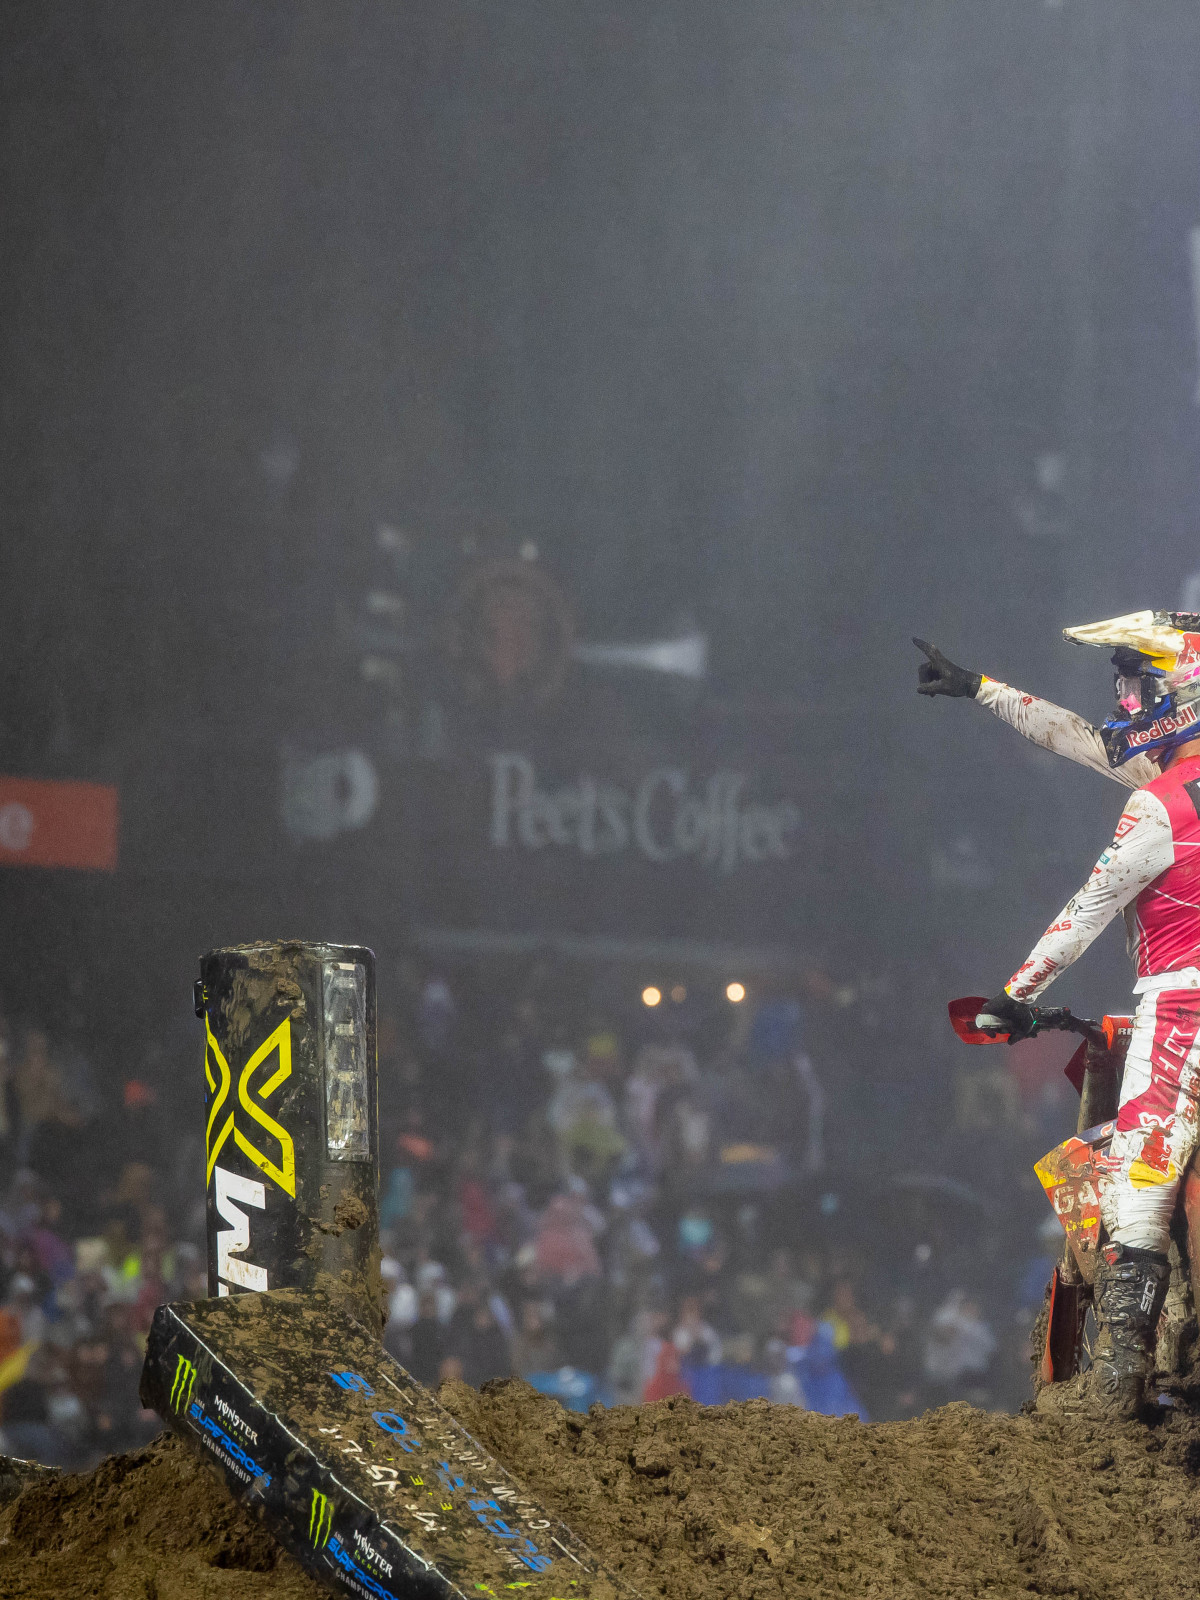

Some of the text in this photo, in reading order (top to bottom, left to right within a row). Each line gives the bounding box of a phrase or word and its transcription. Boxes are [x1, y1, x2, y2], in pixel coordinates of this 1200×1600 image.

[189, 1402, 272, 1488] SUPERCROSS
[201, 1432, 252, 1484] CHAMPIONSHIP
[327, 1536, 400, 1600] SUPERCRO
